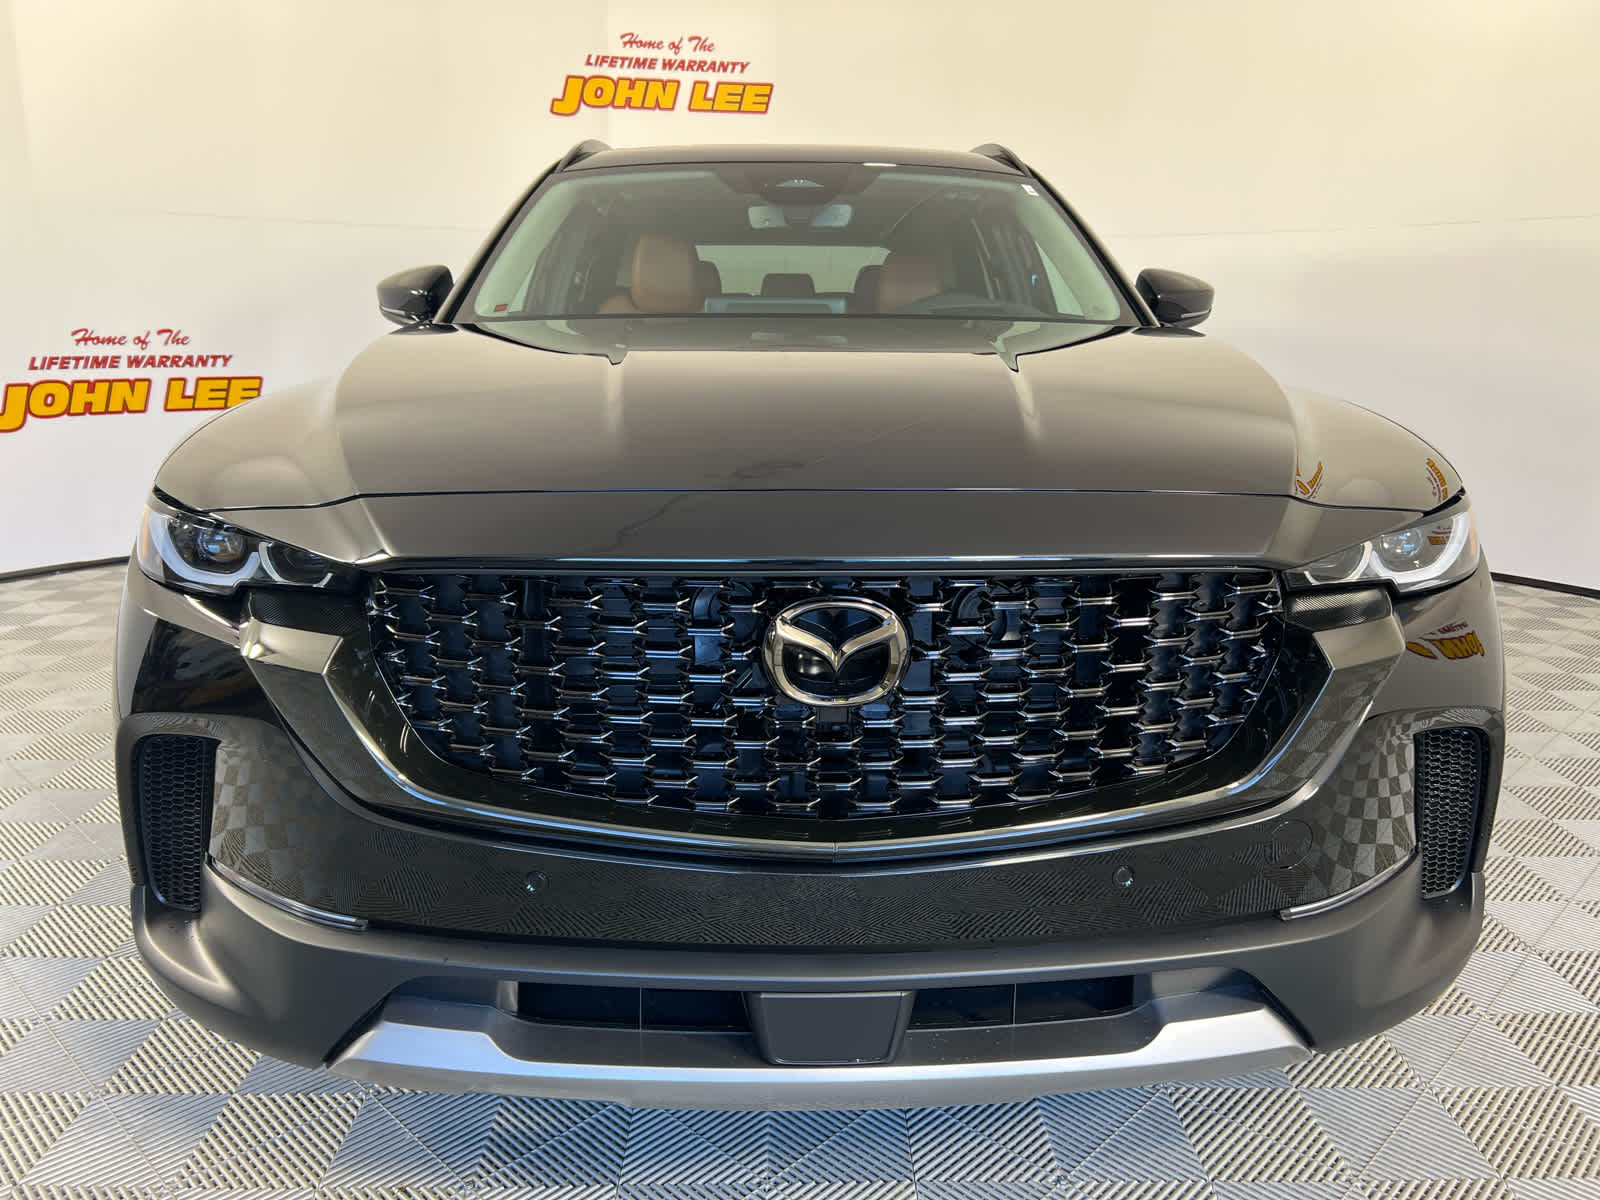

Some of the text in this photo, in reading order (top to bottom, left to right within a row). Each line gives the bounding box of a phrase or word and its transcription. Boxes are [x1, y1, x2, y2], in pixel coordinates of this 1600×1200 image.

[620, 33, 715, 55] Home of The
[585, 54, 750, 73] LIFETIME WARRANTY
[550, 75, 774, 117] JOHN LEE
[71, 328, 190, 350] Home of The
[28, 354, 233, 370] LIFETIME WARRANTY
[0, 376, 263, 433] JOHN LEE
